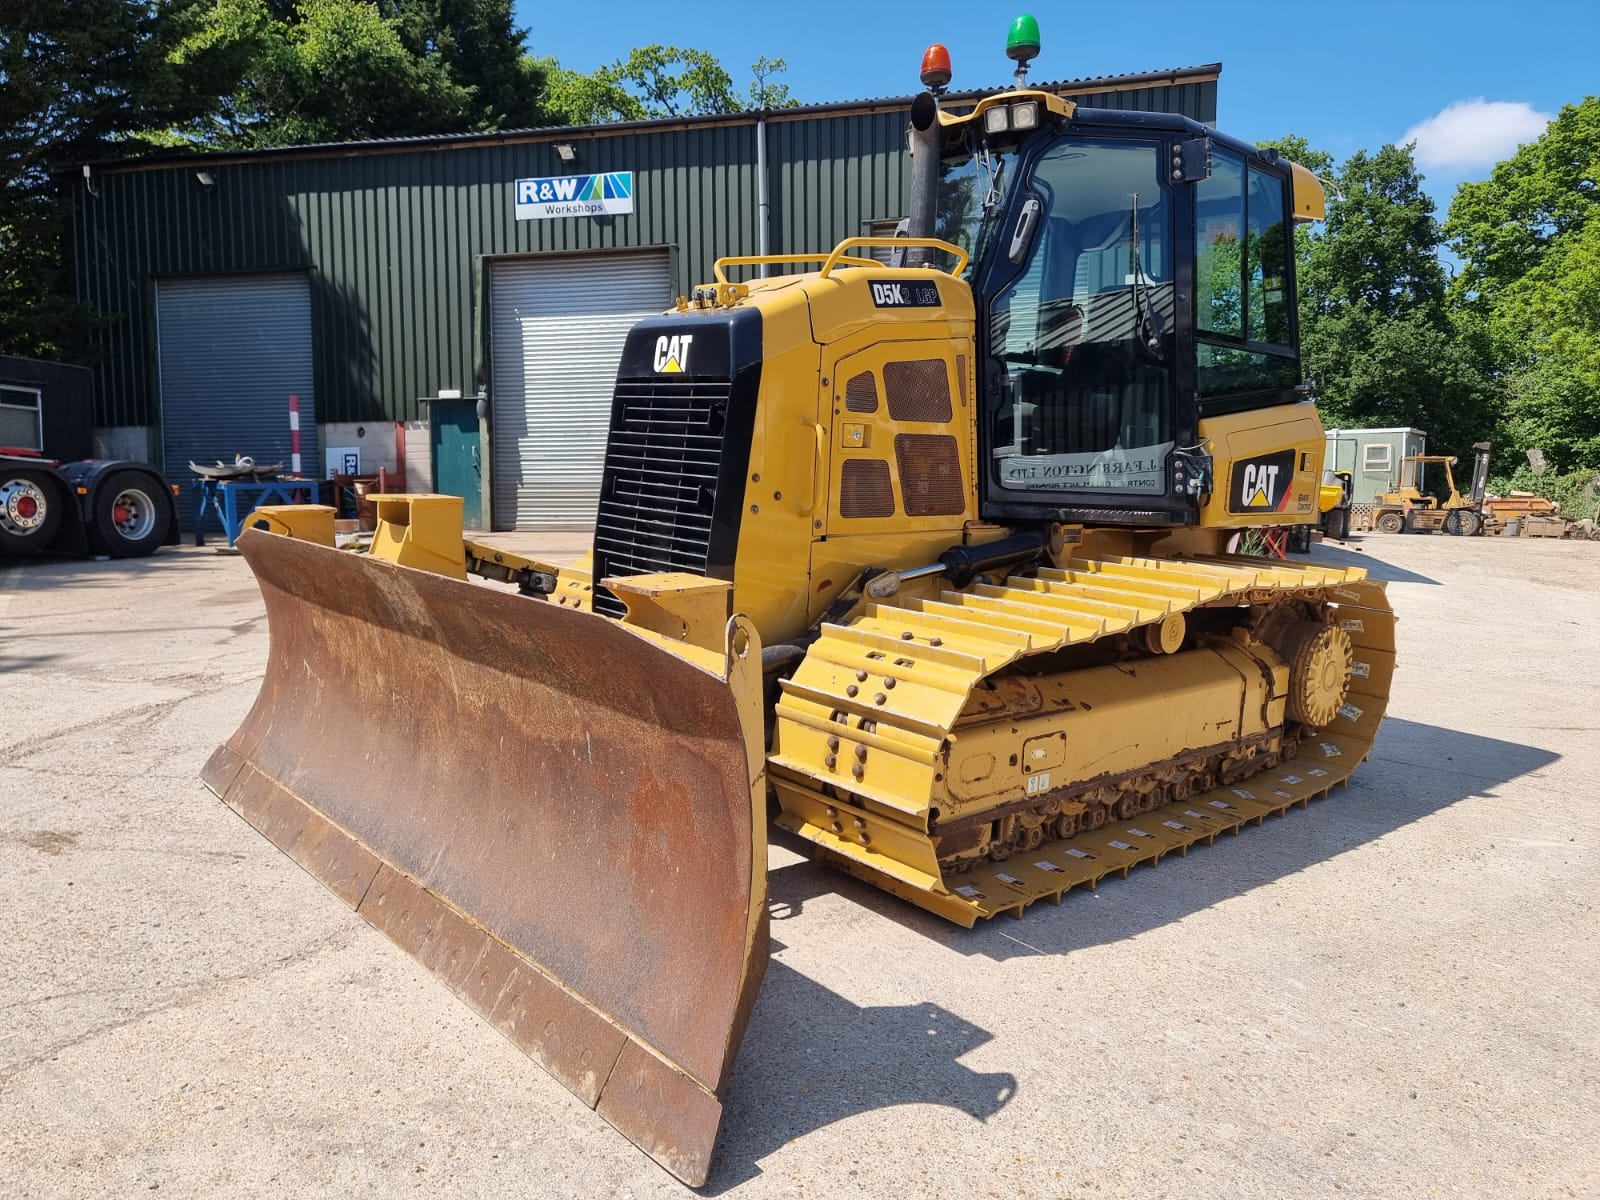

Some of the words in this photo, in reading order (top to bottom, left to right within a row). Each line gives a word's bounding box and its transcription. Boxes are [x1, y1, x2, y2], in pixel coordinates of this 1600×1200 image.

[519, 179, 577, 203] R&W
[545, 203, 603, 215] Workshops
[916, 288, 937, 304] LGP
[653, 334, 693, 373] CAT
[346, 455, 357, 476] R&
[1242, 463, 1279, 507] CAT
